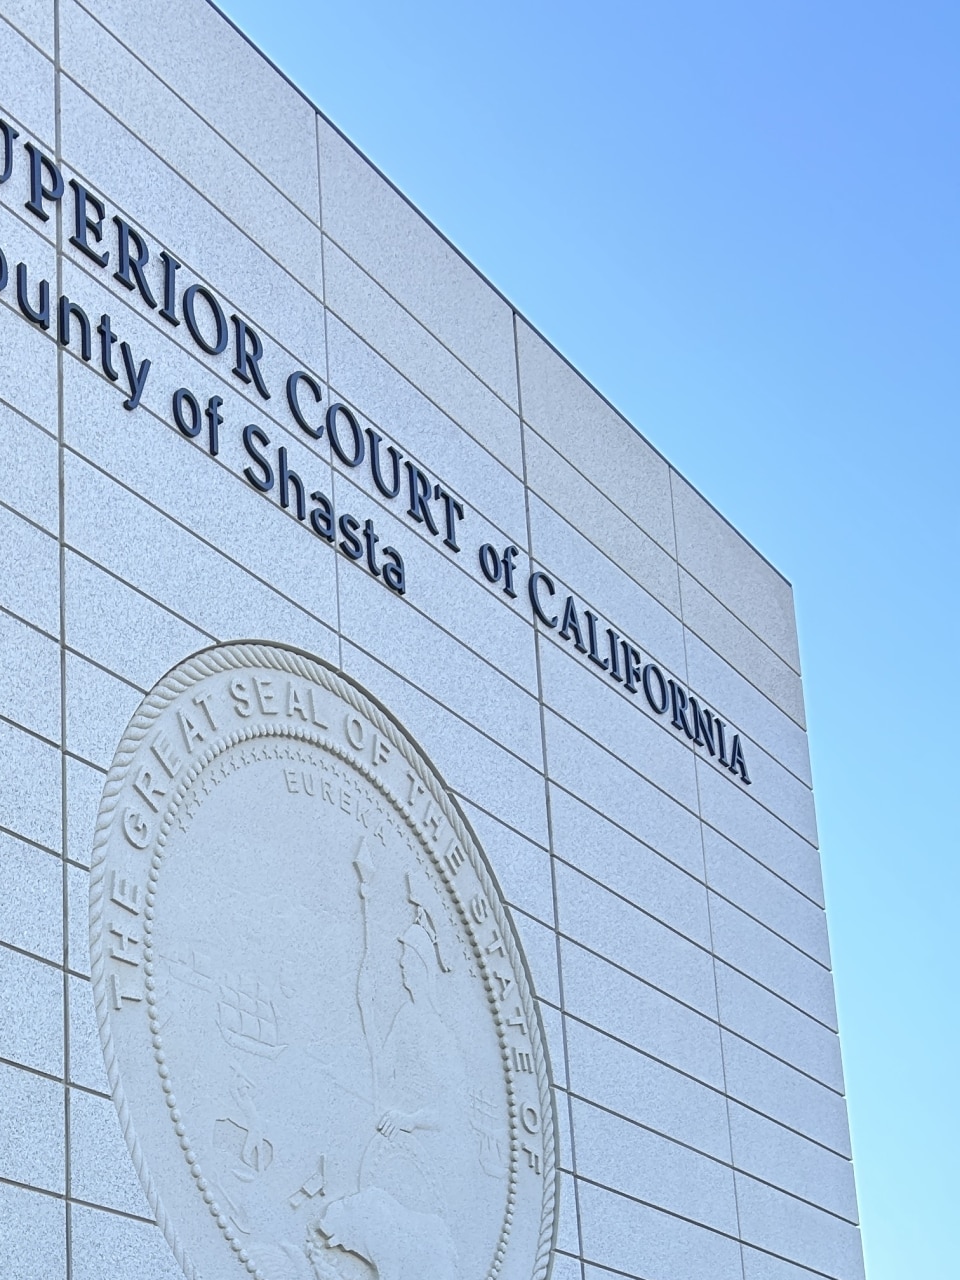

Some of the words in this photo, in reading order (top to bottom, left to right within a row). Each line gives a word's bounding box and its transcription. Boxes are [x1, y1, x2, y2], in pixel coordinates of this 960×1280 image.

[173, 386, 224, 456] of
[243, 424, 406, 594] Shasta
[286, 370, 465, 552] COURT
[479, 543, 518, 599] of
[528, 571, 752, 785] CALIFORNIA
[229, 676, 329, 730] SEAL
[345, 714, 390, 766] OF
[123, 695, 218, 850] GREAT
[284, 768, 386, 847] EUREKA
[405, 769, 465, 876] THE
[109, 870, 143, 1010] THE
[470, 894, 534, 1074] STATE
[520, 1101, 541, 1174] OF
